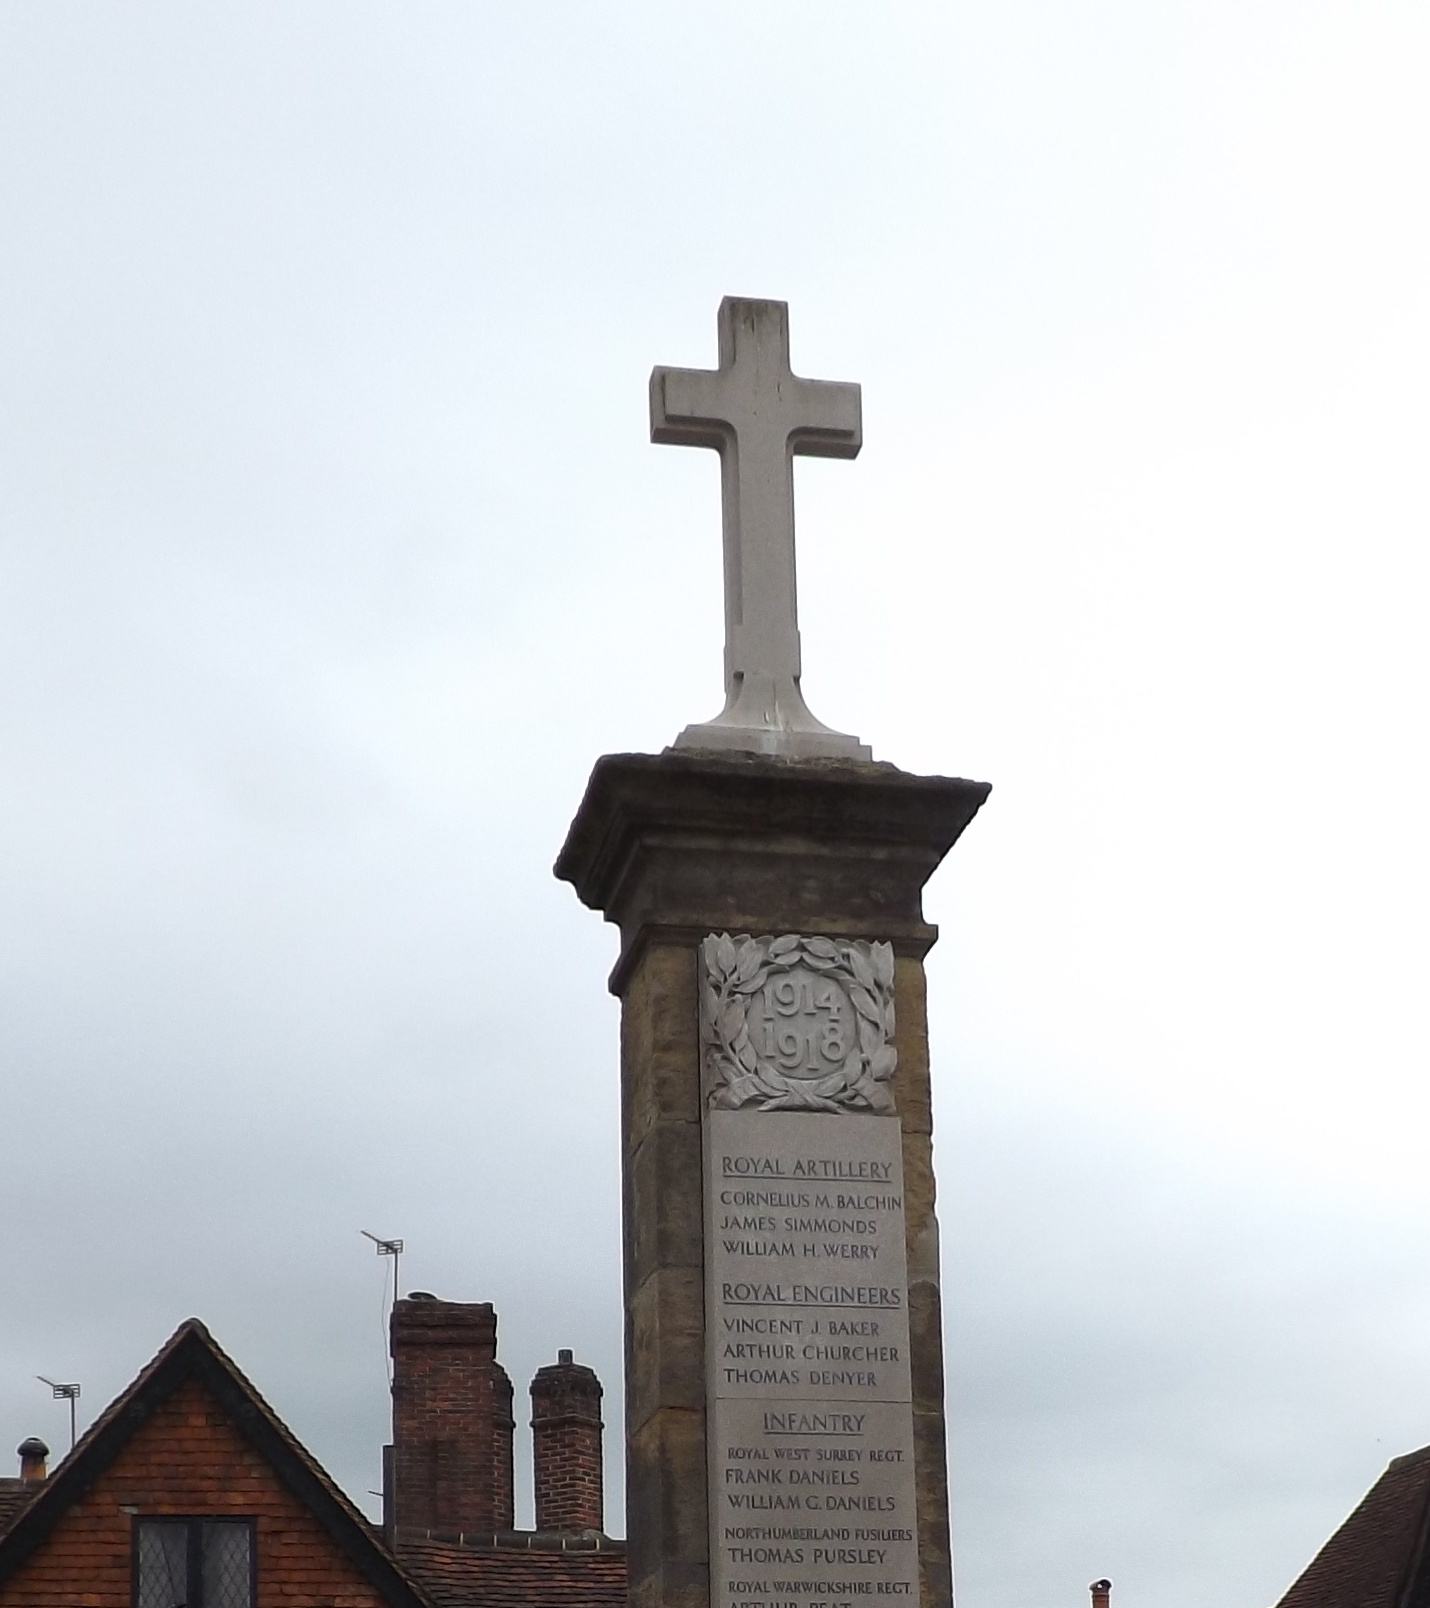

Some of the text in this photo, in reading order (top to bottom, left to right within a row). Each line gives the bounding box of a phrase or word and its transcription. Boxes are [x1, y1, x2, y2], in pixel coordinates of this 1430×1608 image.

[762, 981, 842, 1021] 1914
[763, 1022, 846, 1071] 1918
[723, 1157, 892, 1179] ROYAL ARTILLERY
[721, 1191, 902, 1211] CORNELIUS M. BALCHIN
[721, 1216, 877, 1235] JAMES SIMMONDS
[723, 1240, 795, 1256] WILLIAM
[824, 1244, 879, 1259] WERRY
[722, 1283, 900, 1305] ROYAL ENGINEERS
[723, 1318, 803, 1334] VINCENT
[829, 1321, 879, 1336] BAKER
[723, 1344, 900, 1362] ARTHUR CHURCHER
[723, 1368, 877, 1386] THOMAS DENYER
[763, 1412, 866, 1432] INFANTRY
[728, 1448, 905, 1463] ROYAL WEST SURREY REGT.
[726, 1468, 860, 1485] FRANK DANIELS
[727, 1494, 801, 1510] WILLIAM
[825, 1496, 896, 1511] DANIELS
[725, 1527, 913, 1541] NORTHUMBERLAND FUSILIERS
[727, 1548, 888, 1565] THOMAS PURSLEY
[728, 1581, 913, 1595] ROYAL WARWICKSHIRE REGT.
